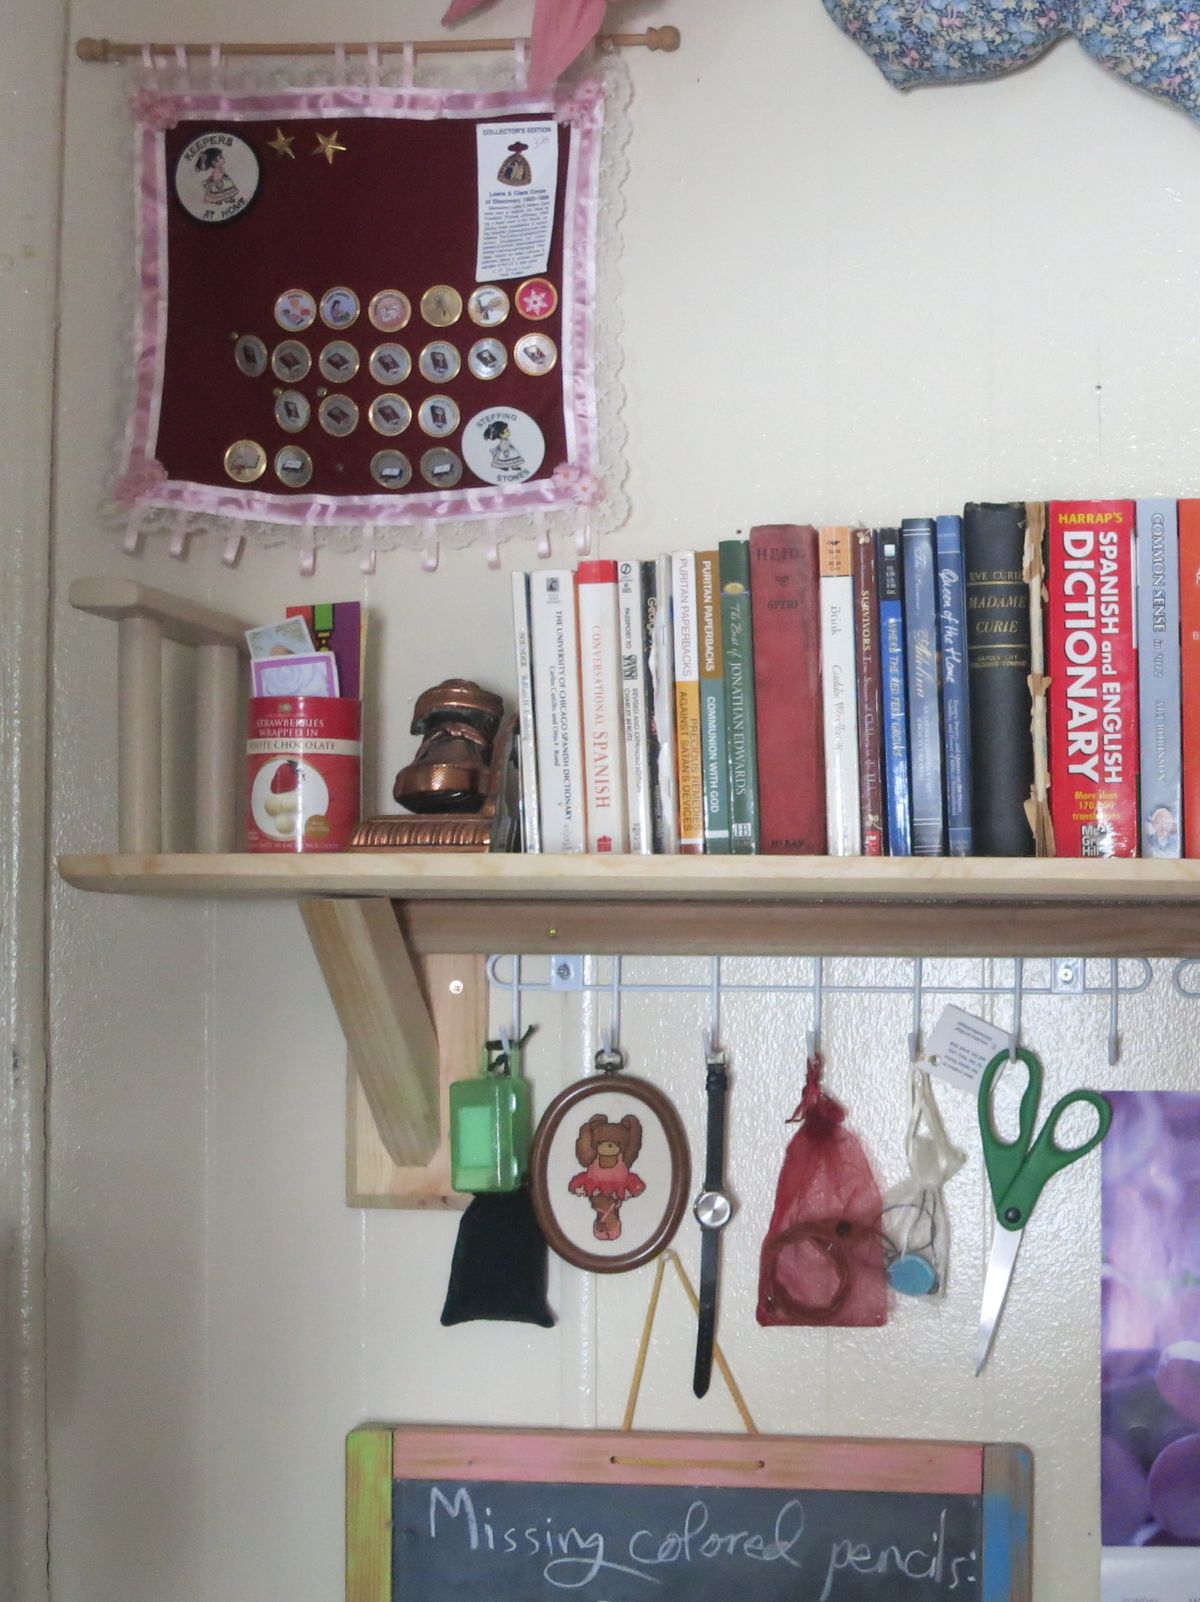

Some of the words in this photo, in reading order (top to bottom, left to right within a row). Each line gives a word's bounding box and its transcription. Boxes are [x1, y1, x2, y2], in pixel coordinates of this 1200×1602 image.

[183, 135, 234, 162] KEEPERS
[202, 209, 216, 219] AT
[221, 197, 246, 218] HOME
[475, 412, 518, 429] STEPPING
[496, 469, 530, 483] STONES
[1058, 512, 1124, 525] HARRAP'S
[1150, 512, 1165, 586] COMMON
[679, 559, 690, 602] PURITAN
[702, 560, 714, 603] PURITAN
[939, 568, 959, 608] Queen
[968, 595, 1026, 609] MADAME
[1098, 531, 1120, 635] SPANISH
[555, 610, 564, 625] THE
[861, 590, 872, 652] SURVIVORS
[940, 609, 960, 624] of
[975, 620, 1020, 633] CURIE
[1152, 589, 1167, 632] SENSE
[556, 627, 567, 675] UNIVERSITY
[681, 605, 692, 678] PAPERBACKS
[703, 605, 716, 672] PAPERBACKS
[943, 625, 959, 644] the
[591, 625, 605, 728] CONVERSATIONAL
[889, 656, 900, 674] THE
[944, 647, 963, 684] Home
[1063, 531, 1099, 784] DICTIONARY
[1100, 641, 1118, 676] and
[559, 676, 567, 689] OF
[729, 662, 743, 732] JONATHAN
[559, 690, 569, 731] CHICAGO
[678, 691, 690, 738] AGAINST
[706, 696, 718, 760] COMMUNION
[306, 728, 319, 737] IN
[561, 732, 572, 767] SPANISH
[689, 718, 699, 773] PRECIOUS
[1101, 682, 1124, 785] ENGLISH
[592, 731, 612, 809] SPANISH
[708, 761, 719, 788] WITH
[732, 733, 746, 797] EDWARDS
[563, 769, 575, 822] DICTIONARY
[682, 784, 693, 832] DEVICES
[709, 789, 720, 813] GOD
[428, 1485, 664, 1589] Missing
[627, 1500, 806, 1567] colored
[820, 1508, 978, 1601] pencils:
